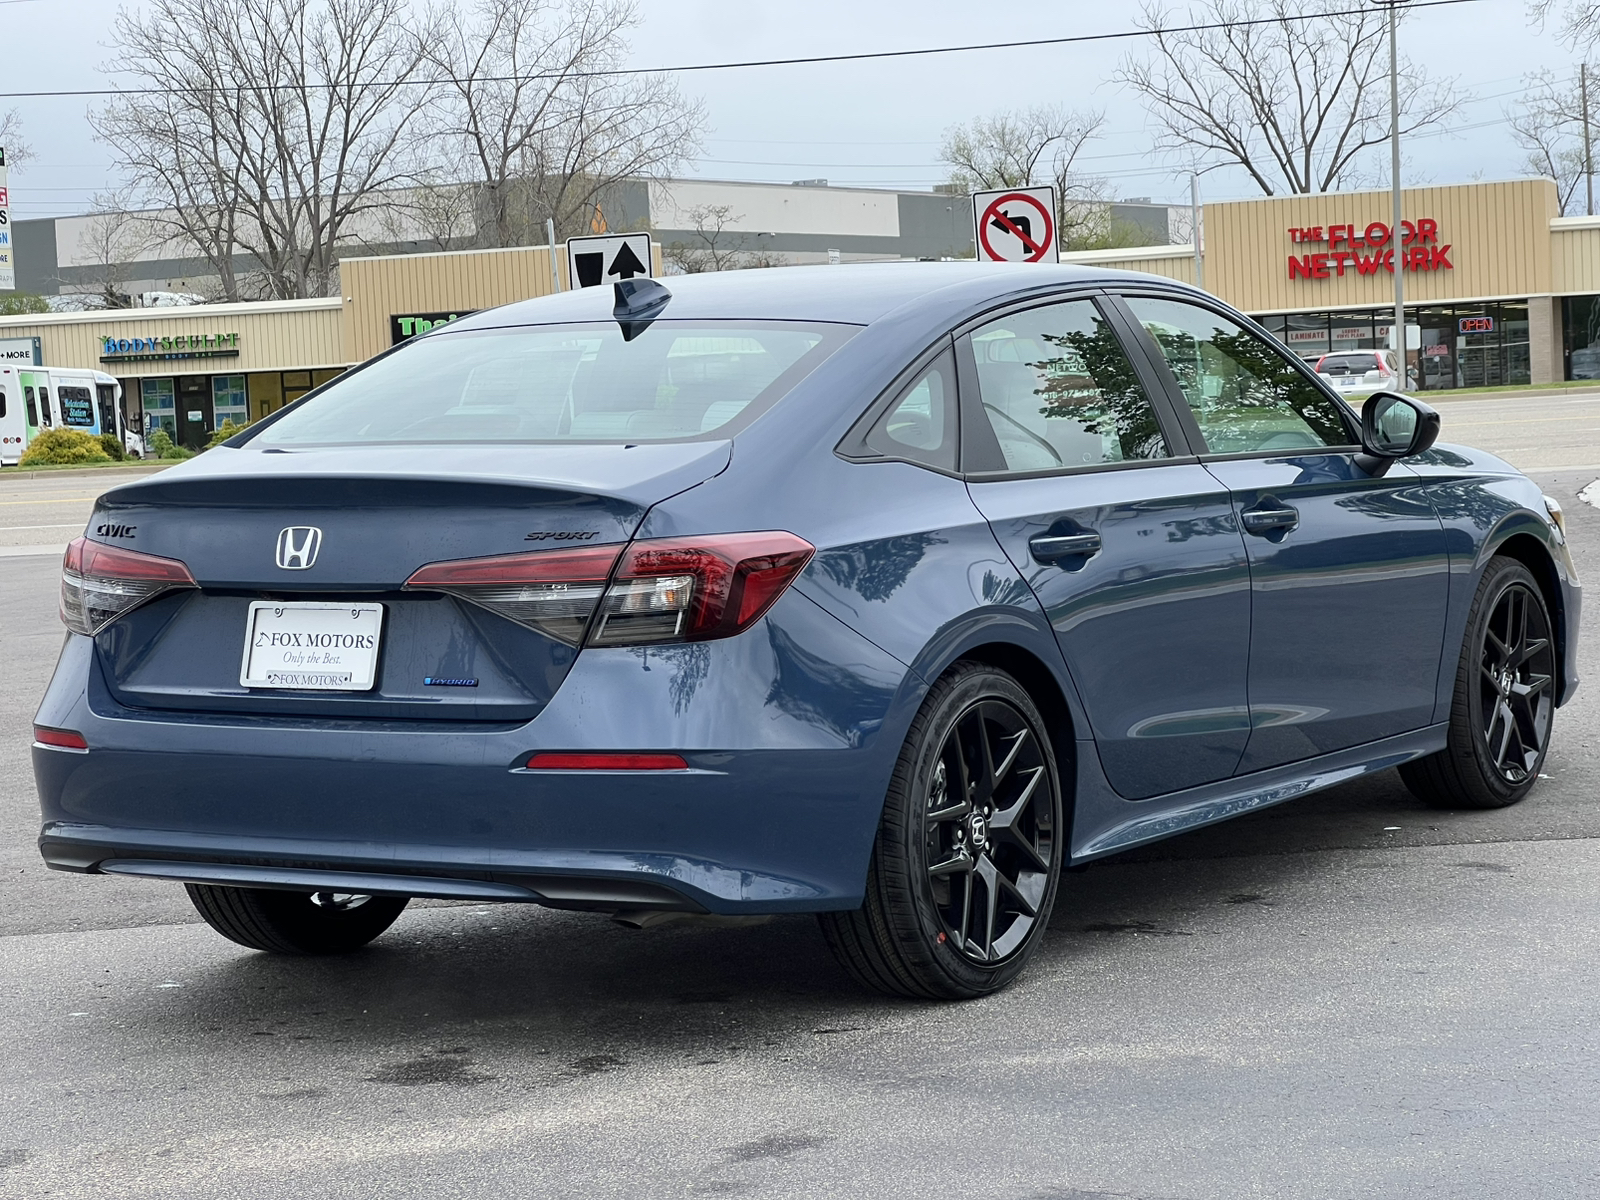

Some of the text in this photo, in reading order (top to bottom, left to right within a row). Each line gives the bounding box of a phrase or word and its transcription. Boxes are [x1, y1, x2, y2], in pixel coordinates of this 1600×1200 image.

[1288, 218, 1438, 250] THE FLOOR
[1288, 244, 1453, 280] NETWORK
[1461, 318, 1493, 331] OPEN
[1290, 331, 1325, 340] LAMINATE
[6, 351, 30, 359] MORE
[97, 524, 137, 538] CIVIC
[524, 531, 600, 541] SPORT
[270, 632, 374, 649] FOX MOTORS
[283, 651, 342, 667] Only the Best.
[279, 673, 344, 686] FOX MOTORS
[431, 678, 475, 686] HYBRID
